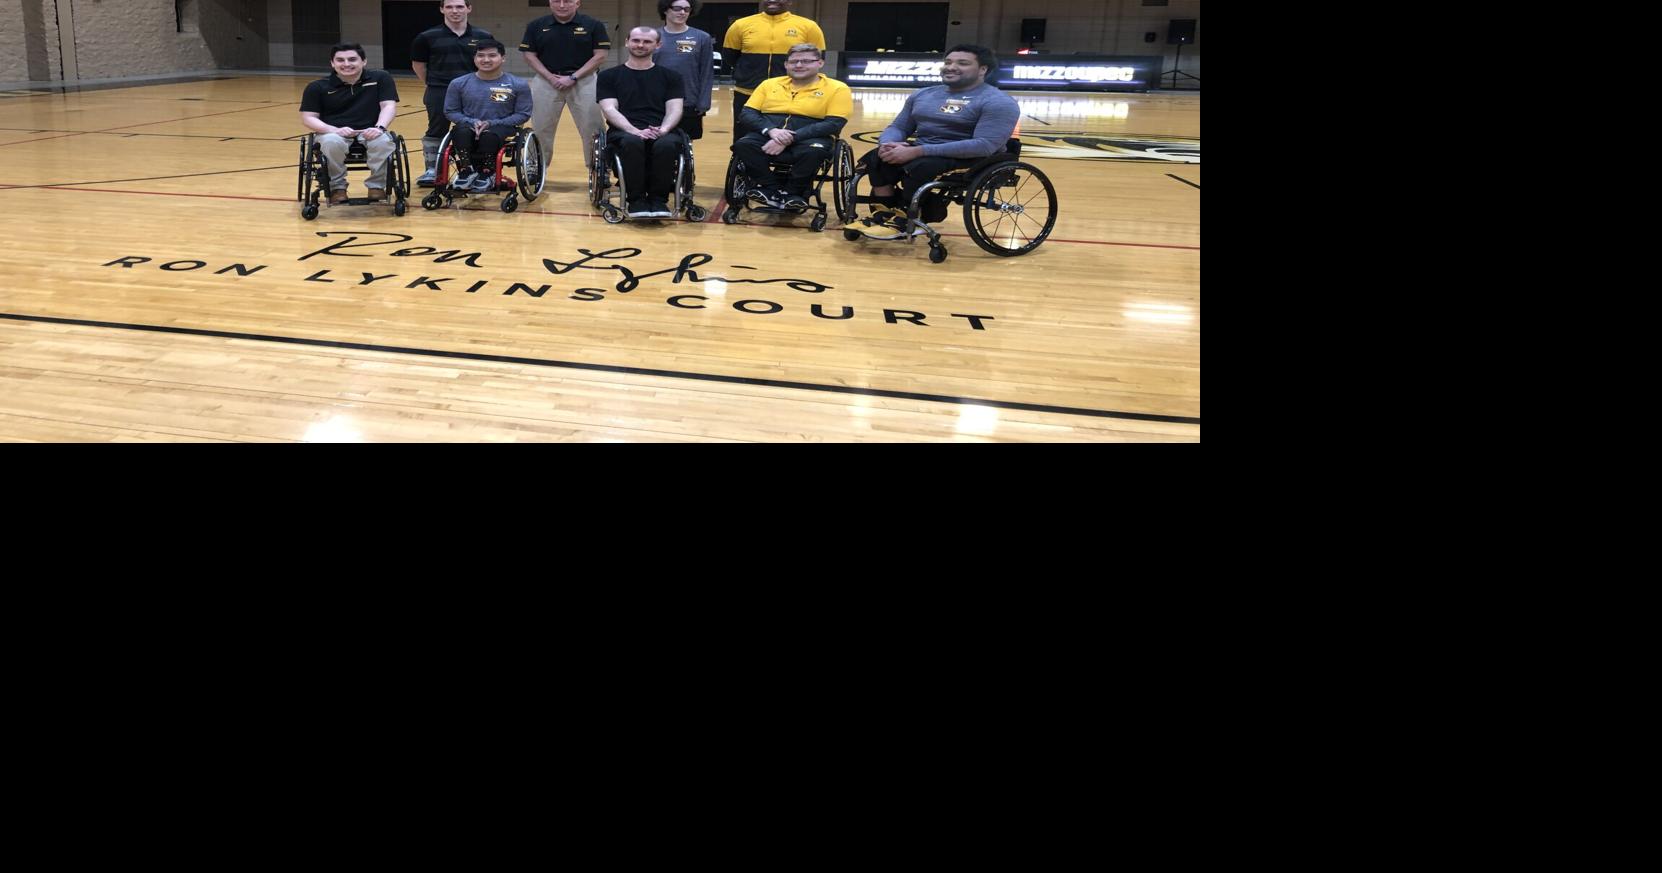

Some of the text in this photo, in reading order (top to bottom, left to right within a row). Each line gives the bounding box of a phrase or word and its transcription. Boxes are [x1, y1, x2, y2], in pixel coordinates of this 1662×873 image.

[298, 231, 483, 268] Ron
[101, 256, 995, 330] RON LYKINS COURT
